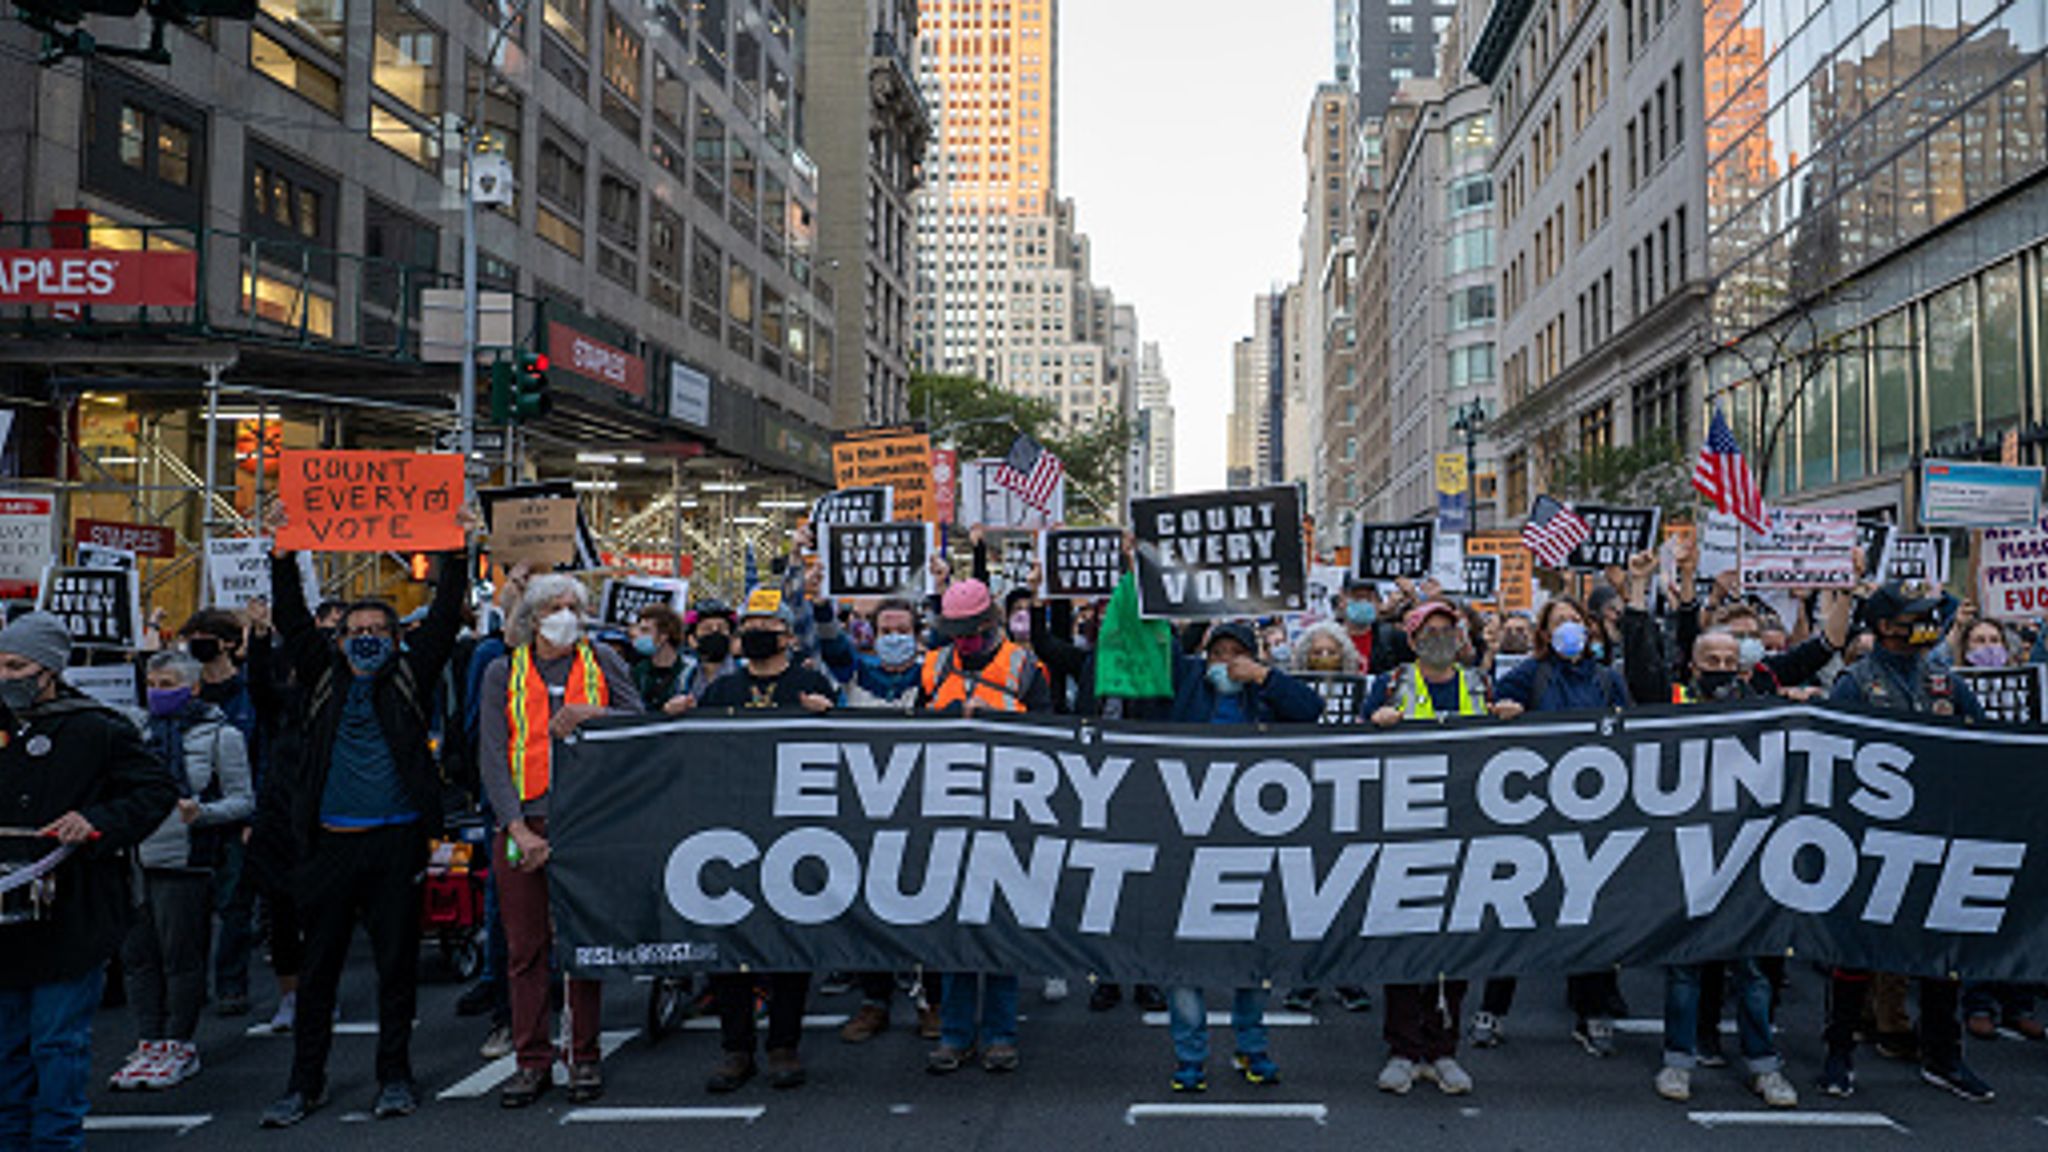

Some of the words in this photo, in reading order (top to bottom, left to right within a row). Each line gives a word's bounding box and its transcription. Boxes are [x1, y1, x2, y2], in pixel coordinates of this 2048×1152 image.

[303, 458, 412, 483] COUNT
[303, 485, 417, 512] EVERY
[307, 515, 413, 543] VOTE
[1156, 502, 1275, 535] COUNT
[840, 531, 912, 547] COUNT
[1159, 530, 1275, 567] EVERY
[840, 547, 912, 563] EVERY
[843, 566, 912, 588] VOTE
[774, 743, 1133, 829] EVERY
[1157, 758, 1448, 835] VOTE
[1476, 730, 1914, 824] COUNTS
[664, 827, 1158, 933] COUNT
[1176, 828, 1648, 939] EVERY
[1676, 816, 2027, 932] VOTE
